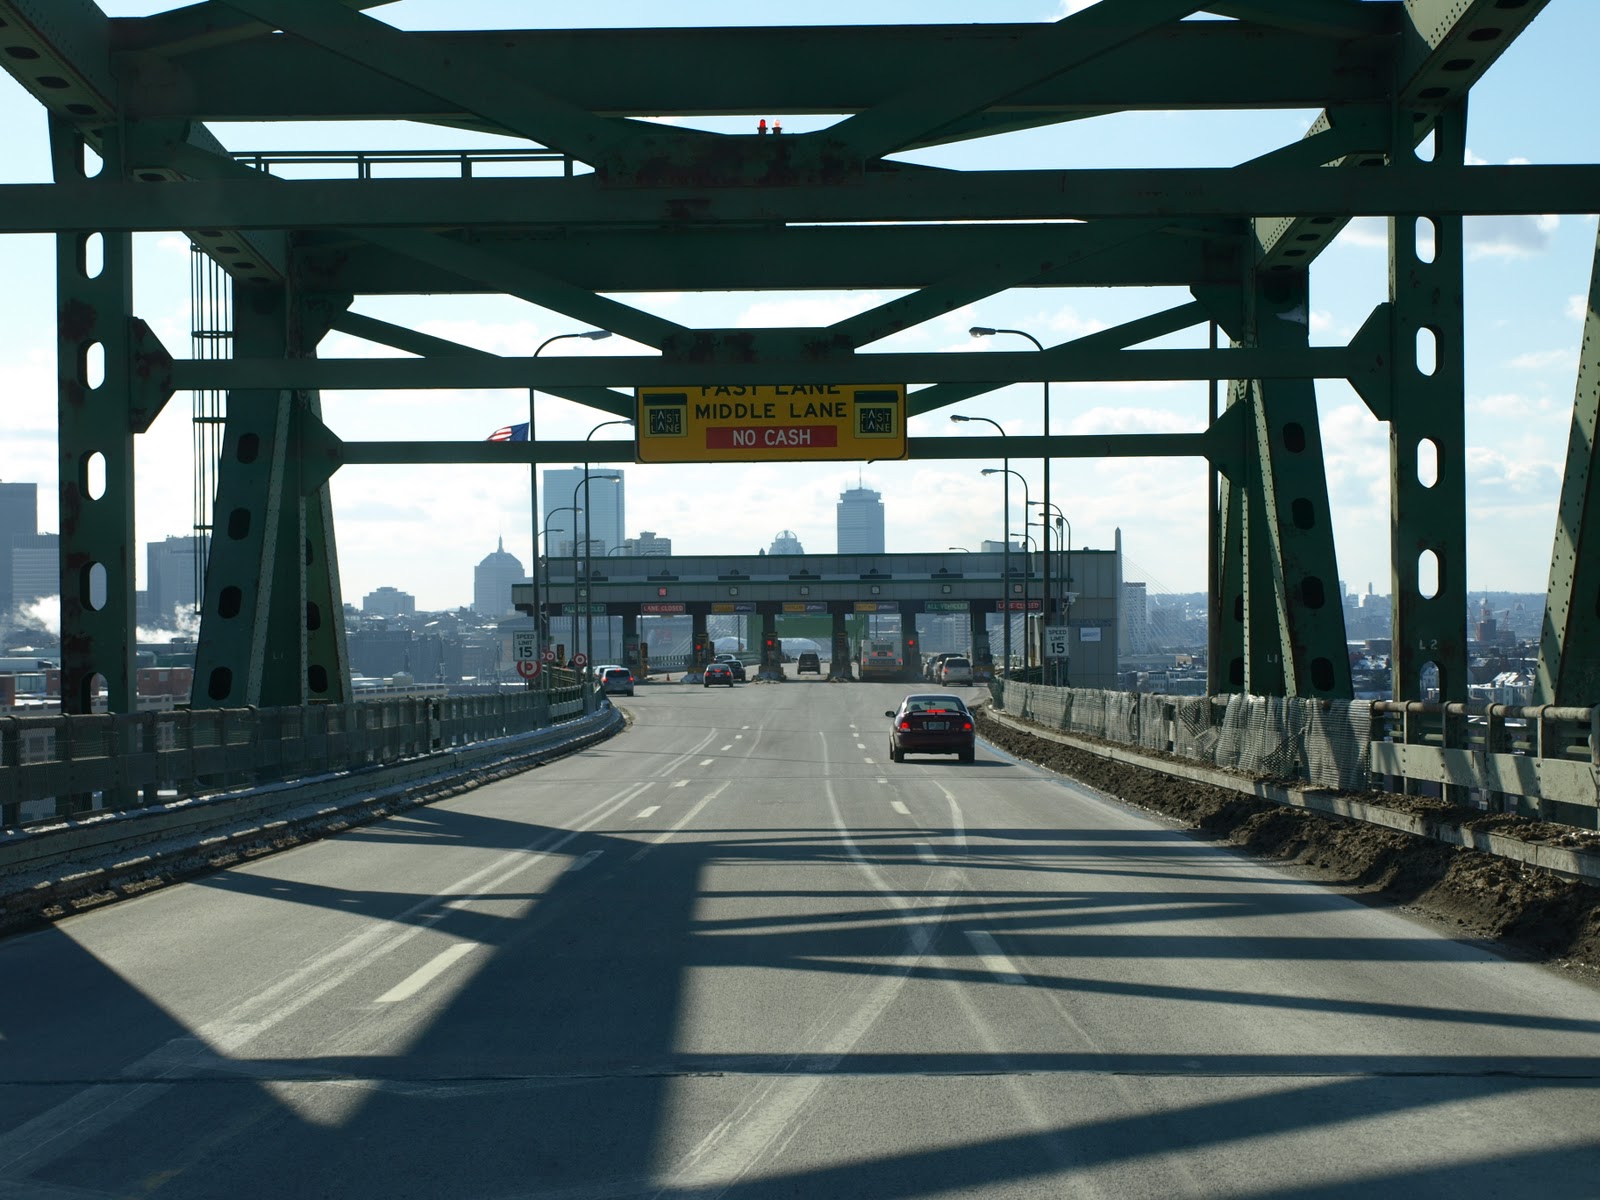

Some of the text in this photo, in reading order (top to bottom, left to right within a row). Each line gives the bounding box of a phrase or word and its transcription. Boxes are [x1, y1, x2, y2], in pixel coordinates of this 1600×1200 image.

[701, 385, 840, 396] FAST LANE
[650, 410, 680, 423] FAST
[695, 402, 847, 419] MIDDLE LANE
[861, 409, 890, 422] FAST
[650, 421, 680, 433] LANE
[861, 420, 890, 432] LANE
[732, 428, 811, 446] NO CASH
[518, 646, 533, 658] 15
[1051, 642, 1065, 654] 15
